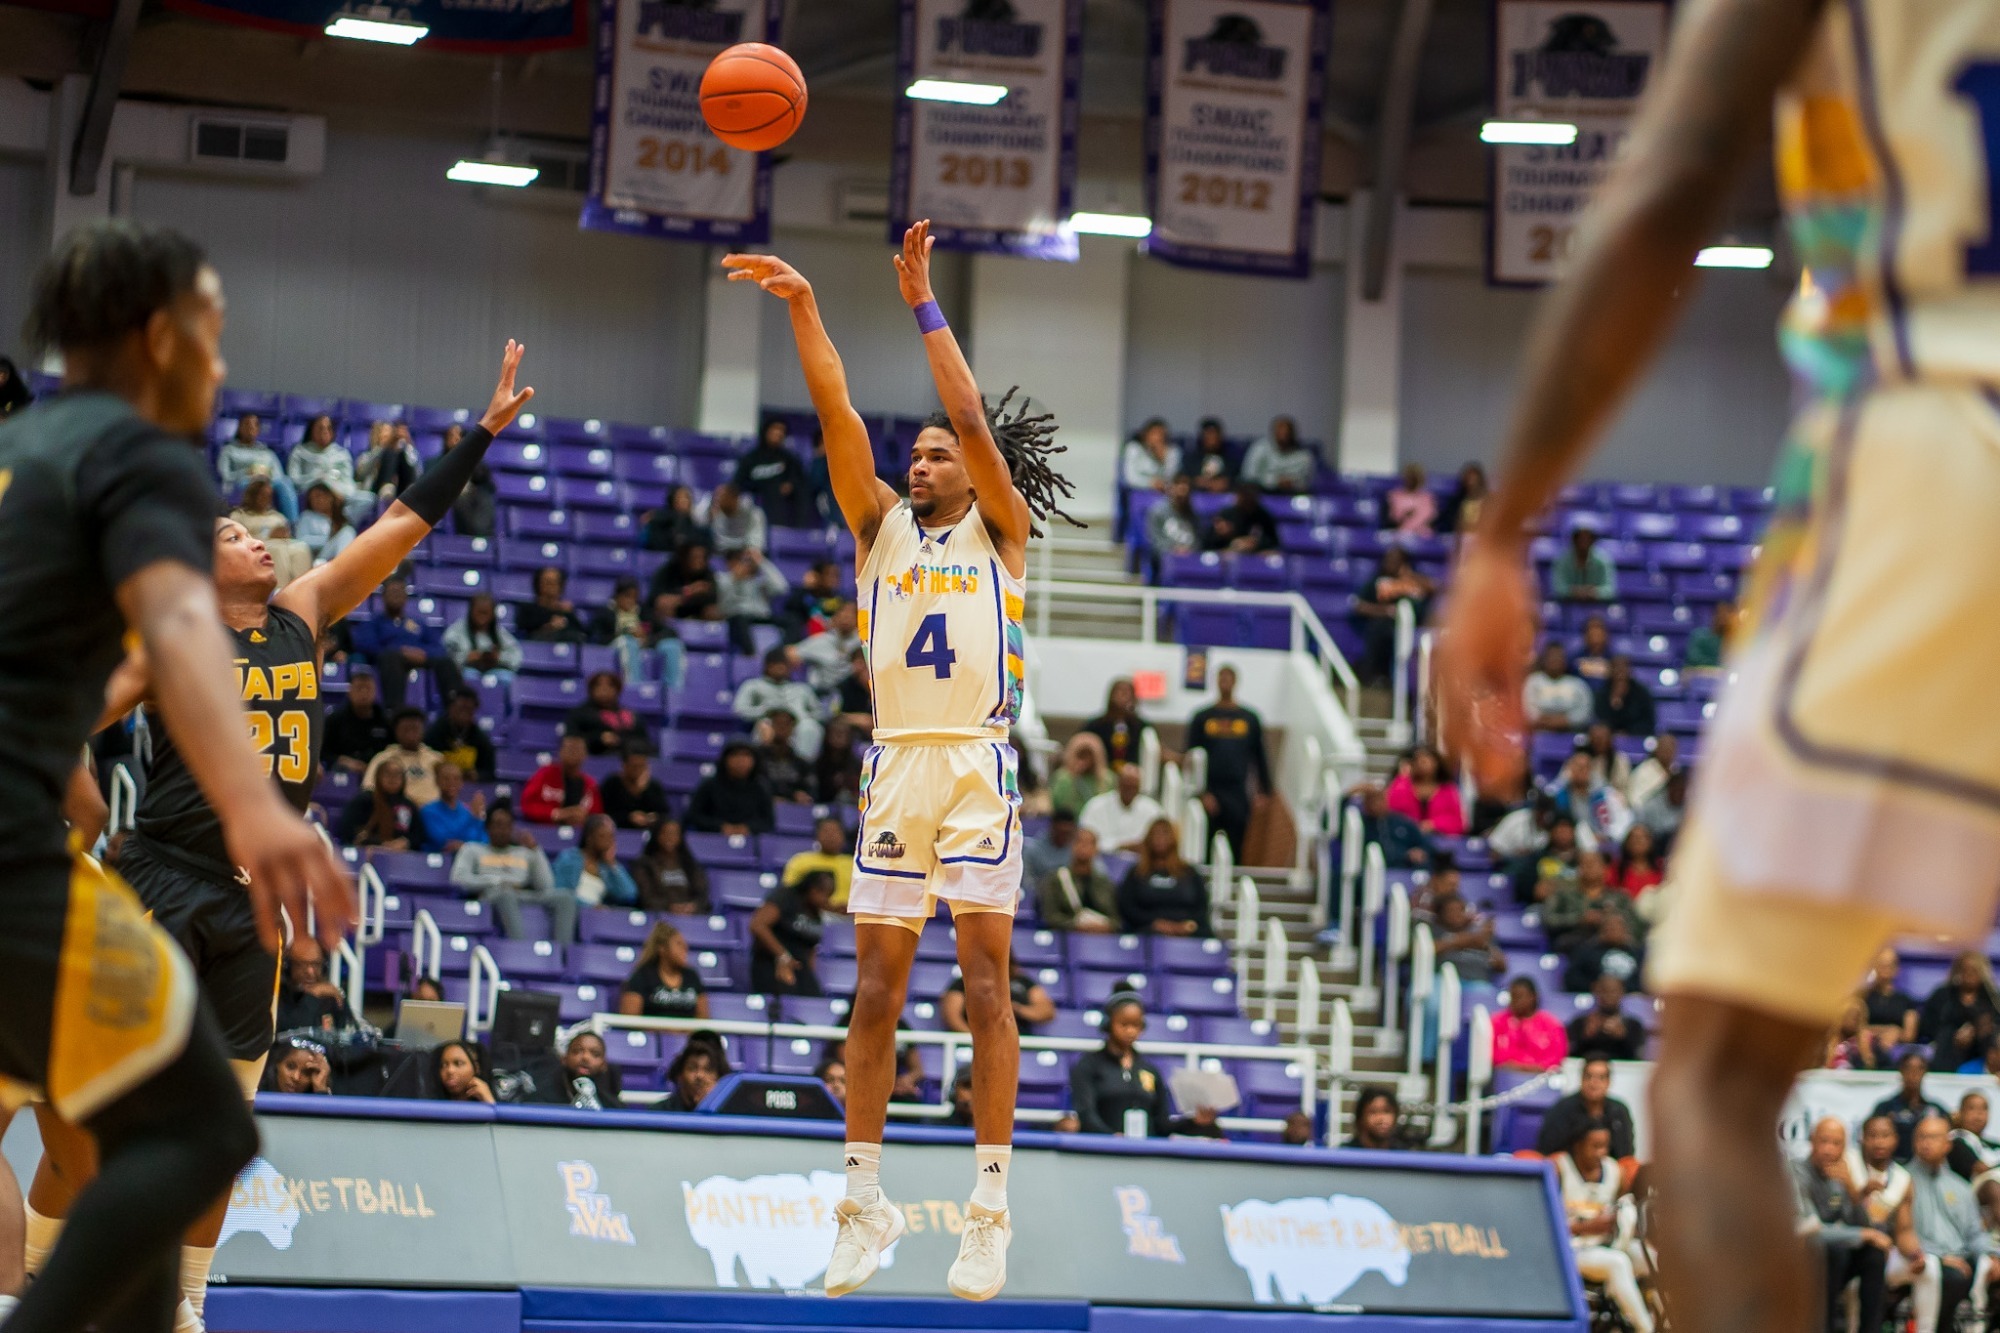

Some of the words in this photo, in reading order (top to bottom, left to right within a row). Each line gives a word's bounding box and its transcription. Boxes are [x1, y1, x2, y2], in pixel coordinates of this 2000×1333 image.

[1191, 102, 1272, 133] SWAC
[637, 135, 732, 176] 2014
[938, 153, 1032, 189] 2013
[1180, 171, 1272, 213] 2012
[906, 613, 957, 680] 4
[246, 710, 310, 783] 23
[229, 1175, 436, 1218] BASKETBALL
[686, 1189, 830, 1230] PANTHER
